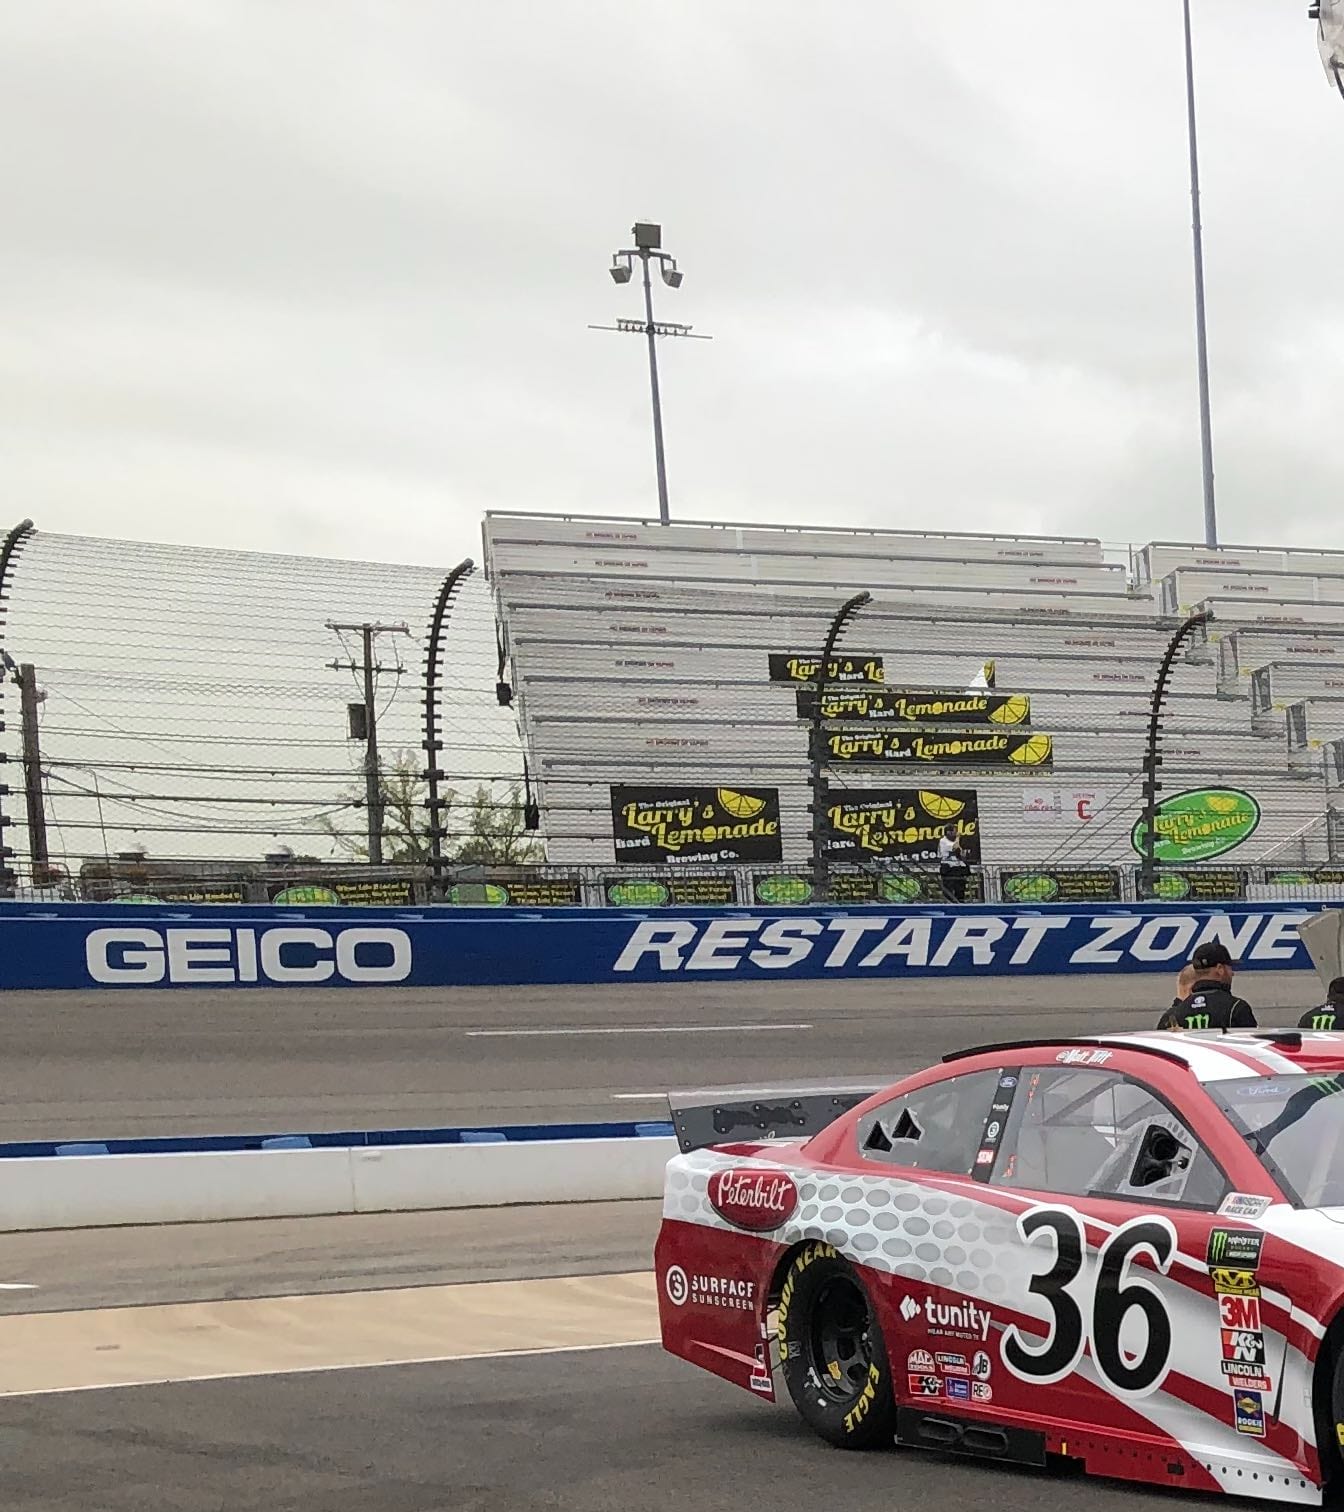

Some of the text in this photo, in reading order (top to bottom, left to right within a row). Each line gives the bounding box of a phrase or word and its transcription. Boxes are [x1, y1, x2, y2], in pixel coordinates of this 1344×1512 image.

[787, 659, 853, 681] Lary's
[895, 696, 987, 721] Lemonade
[828, 734, 901, 758] Larry's
[911, 735, 1008, 760] Lemonade
[622, 800, 715, 831] Larry's
[828, 802, 915, 832] Larry's
[1077, 800, 1093, 820] C
[651, 818, 778, 851] Lemonade
[666, 849, 740, 863] Brewing Co.
[86, 927, 412, 983] GEICO
[613, 914, 1312, 972] RESTART ZONE
[718, 1170, 793, 1212] Peterbilt
[691, 1292, 755, 1312] SUNSCREEN
[778, 1241, 838, 1362] GOODYEAR
[1003, 1207, 1174, 1393] 36
[1221, 1296, 1260, 1330] 3M
[924, 1296, 992, 1342] tunity
[1222, 1363, 1263, 1378] LINCOLN
[843, 1362, 881, 1433] EAGLE
